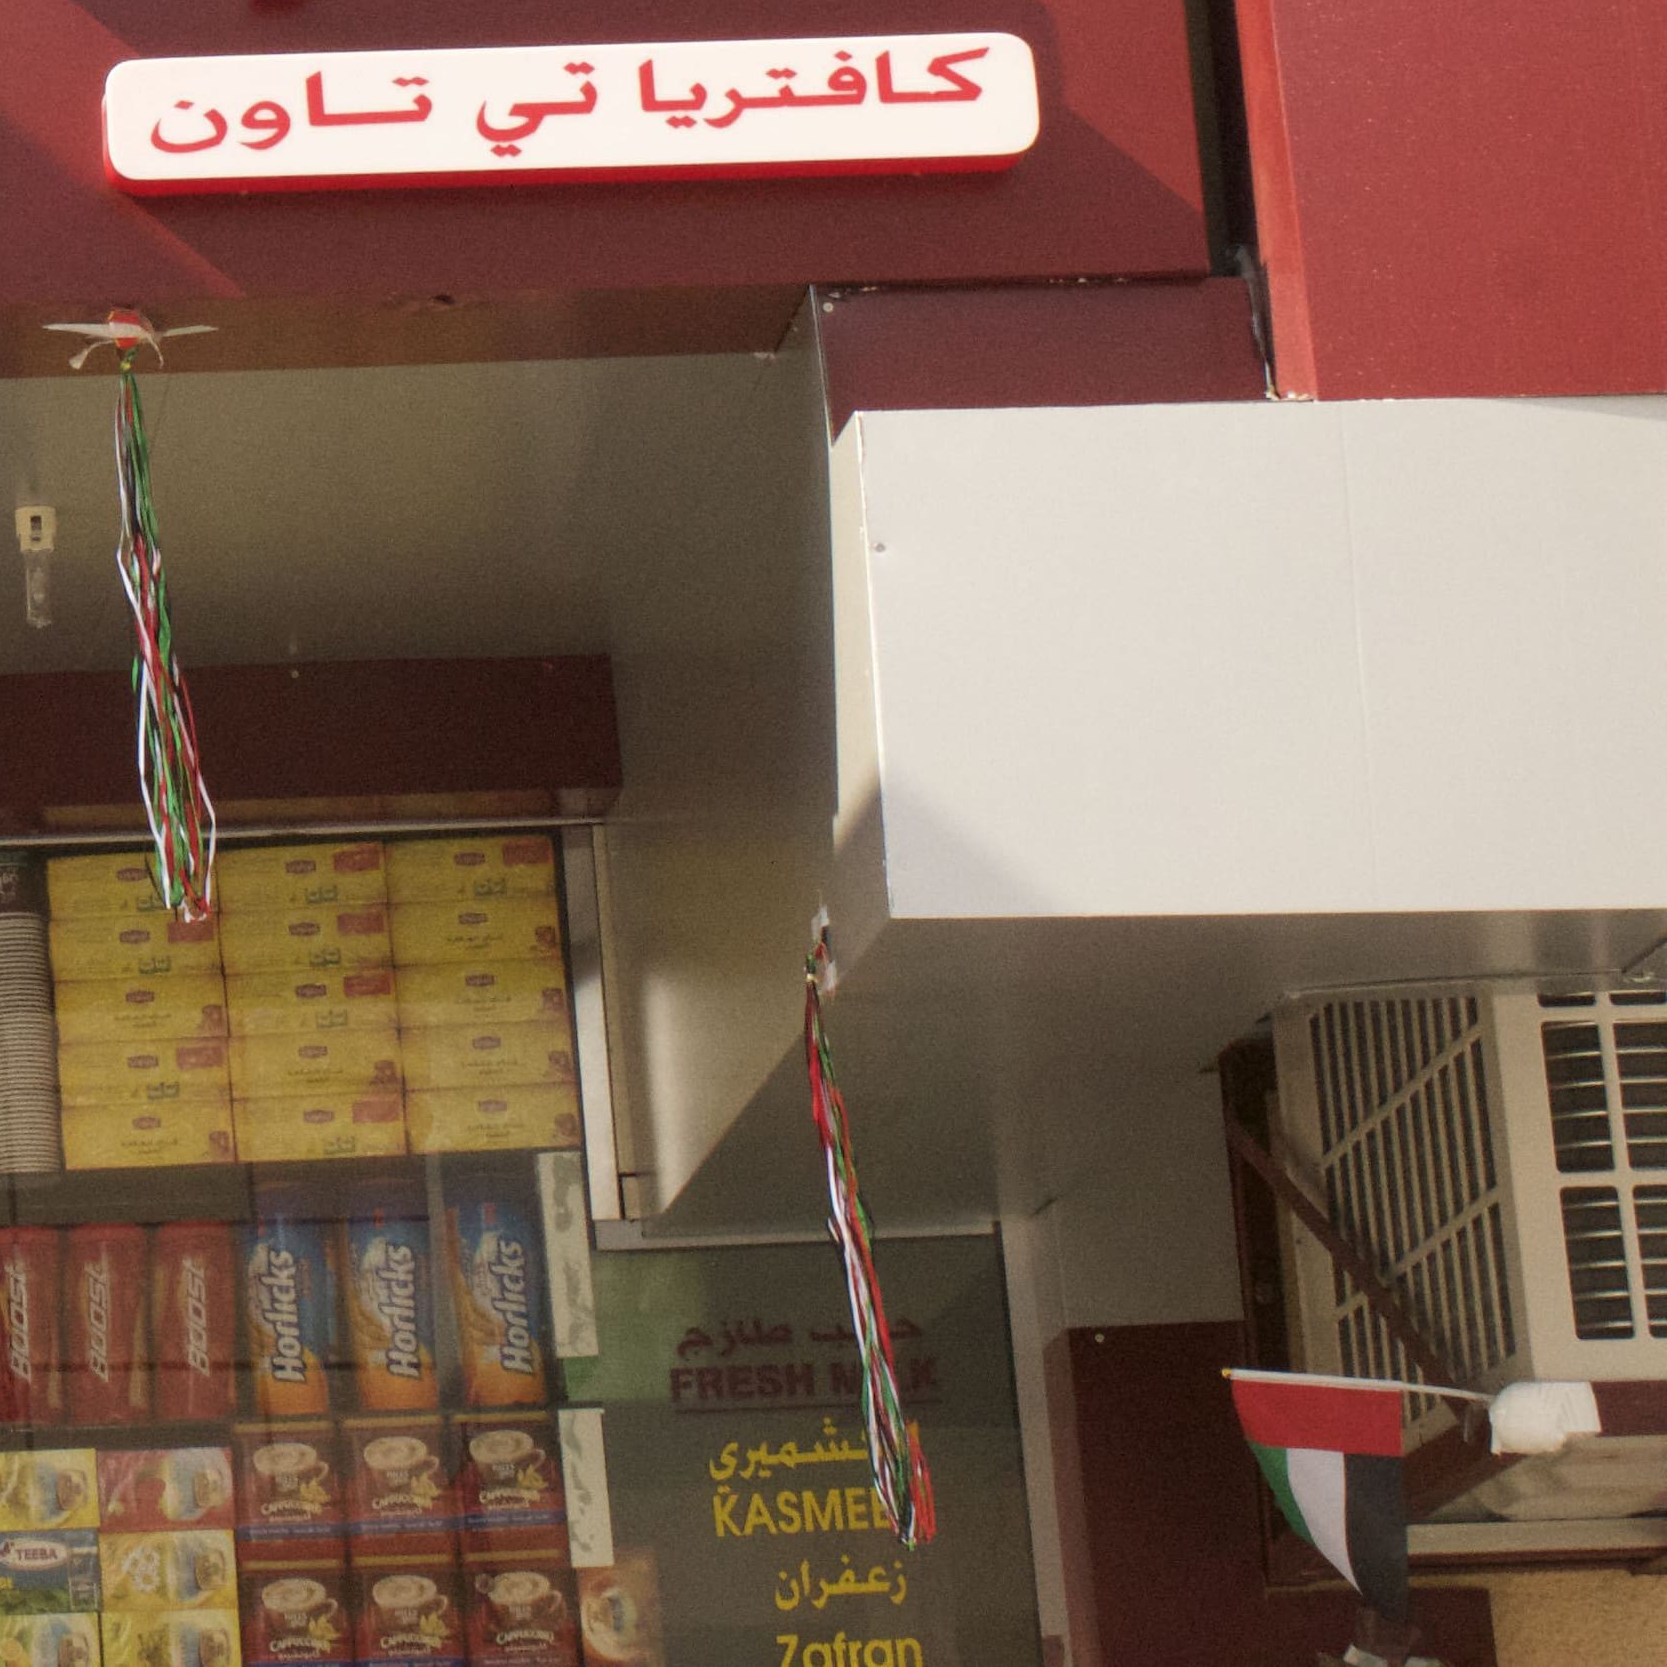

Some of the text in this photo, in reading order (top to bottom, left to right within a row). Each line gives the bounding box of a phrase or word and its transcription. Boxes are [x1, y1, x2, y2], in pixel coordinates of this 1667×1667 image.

[148, 47, 992, 157] كافتريا تي تاون
[261, 1249, 307, 1382] Horlicks
[377, 1243, 421, 1378] Horlicks
[491, 1238, 534, 1375] Horlicks
[669, 1356, 938, 1403] FRESH MK
[775, 1554, 908, 1611] زعفران
[775, 1630, 924, 1667] Zafran
